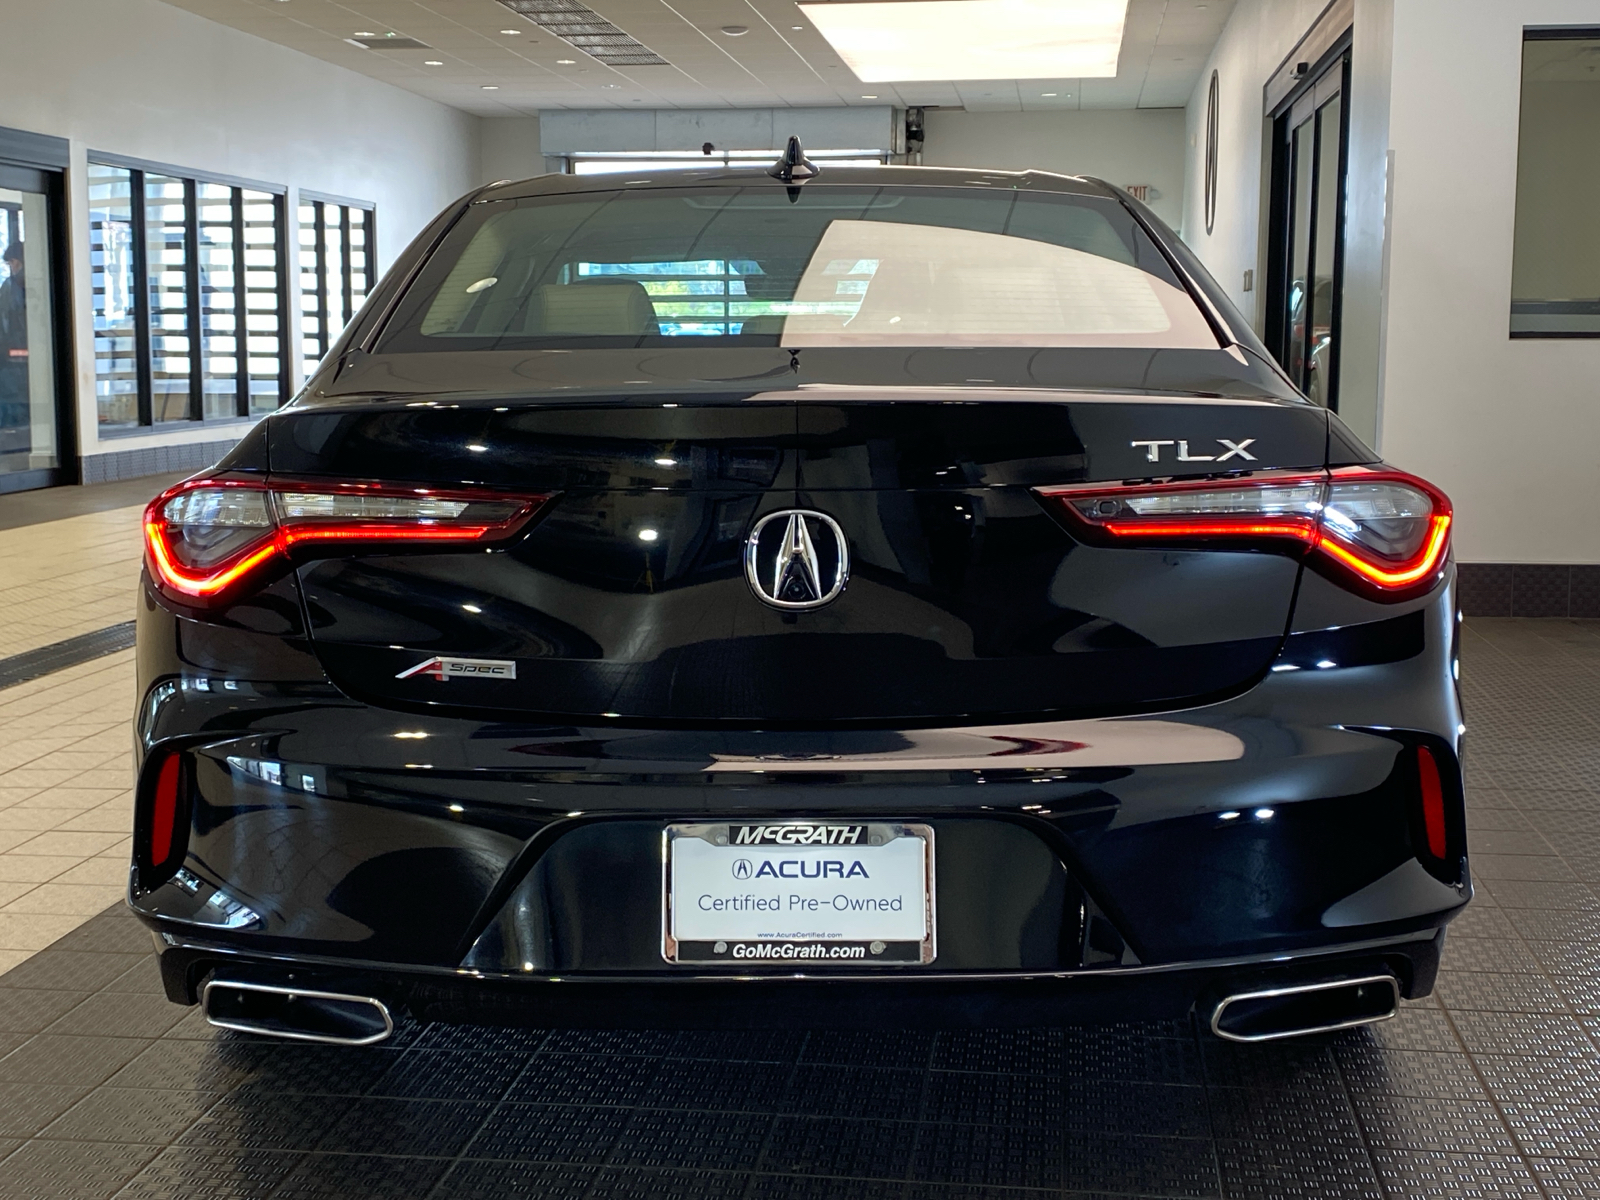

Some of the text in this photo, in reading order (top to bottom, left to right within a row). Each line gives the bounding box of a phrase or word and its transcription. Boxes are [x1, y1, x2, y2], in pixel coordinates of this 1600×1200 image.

[1130, 439, 1258, 462] TLX
[755, 860, 870, 879] ACURA
[698, 894, 903, 911] Certified Pre-Owned
[757, 931, 843, 939] www.AcuraCertified.com
[732, 943, 866, 959] GoMcGrath.com
